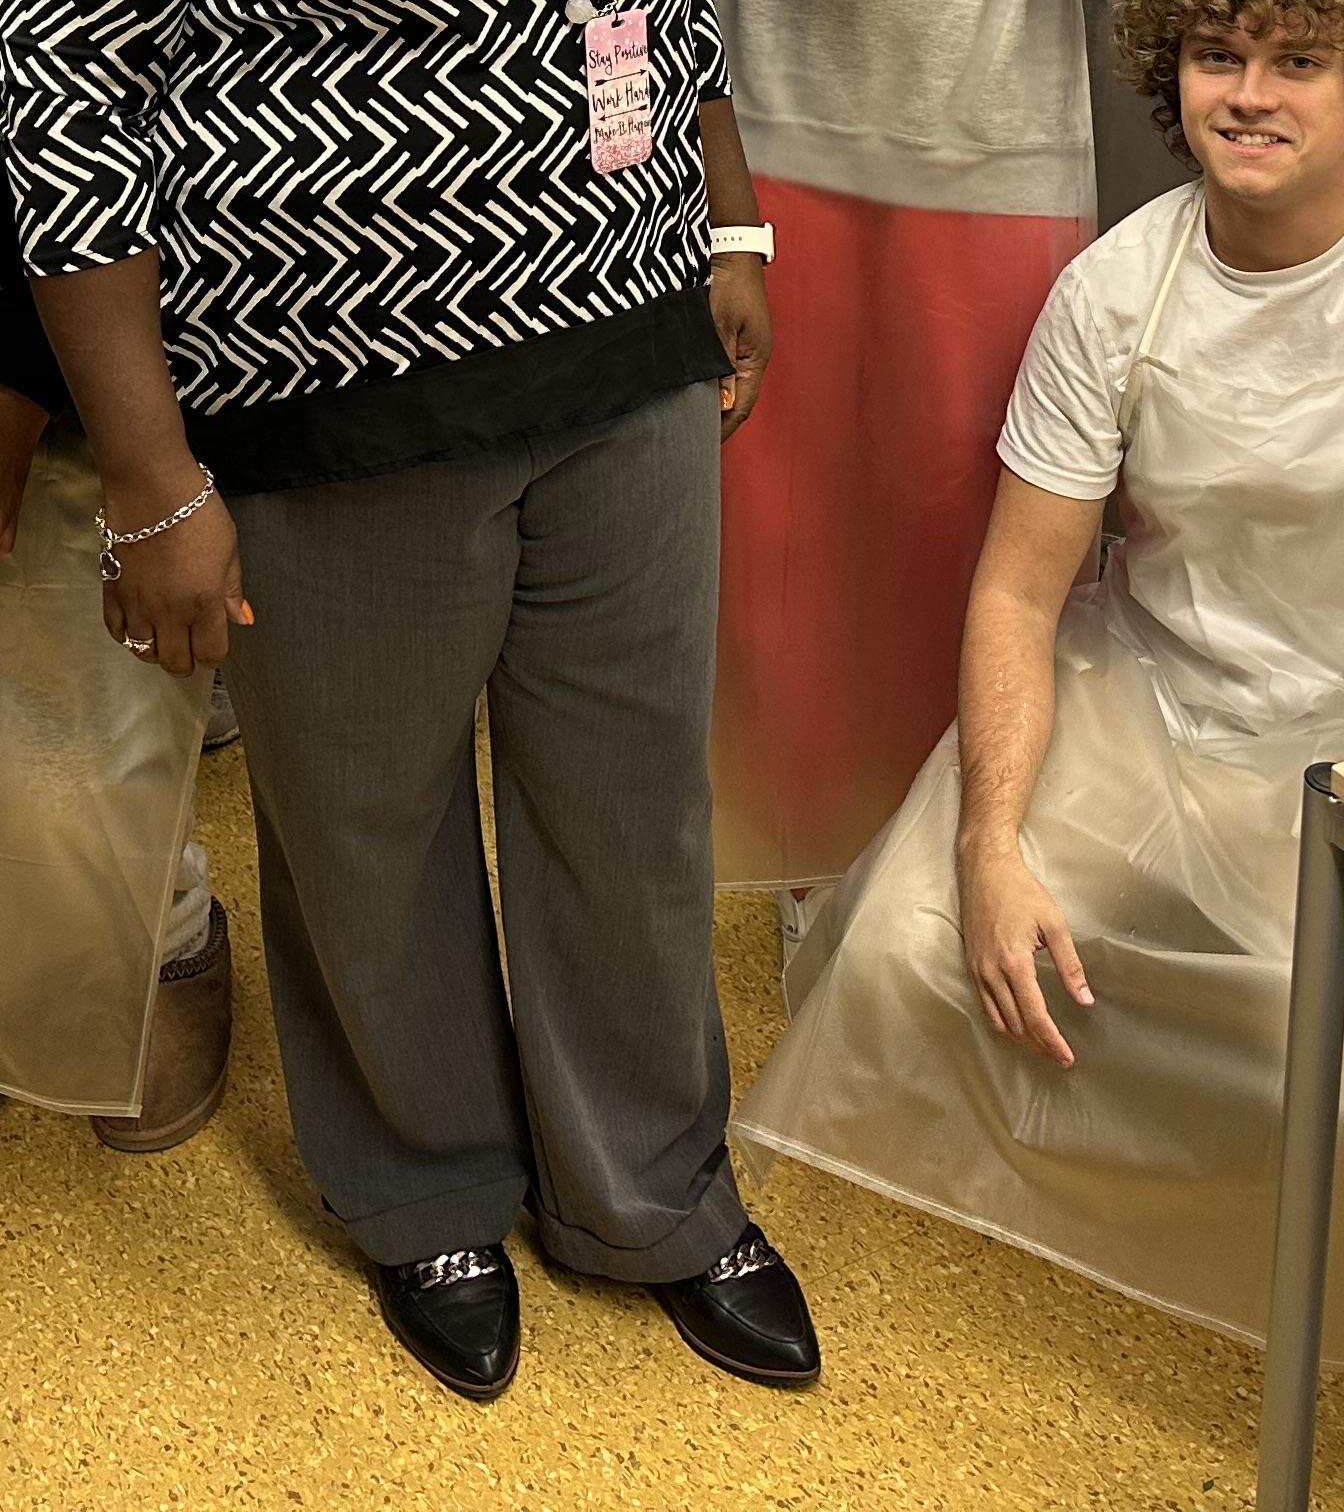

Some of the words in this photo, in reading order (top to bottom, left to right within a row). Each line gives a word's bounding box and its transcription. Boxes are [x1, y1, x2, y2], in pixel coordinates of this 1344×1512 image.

[588, 49, 613, 76] Stay
[614, 41, 648, 65] Positive
[592, 88, 623, 113] Work
[625, 78, 650, 107] Hard
